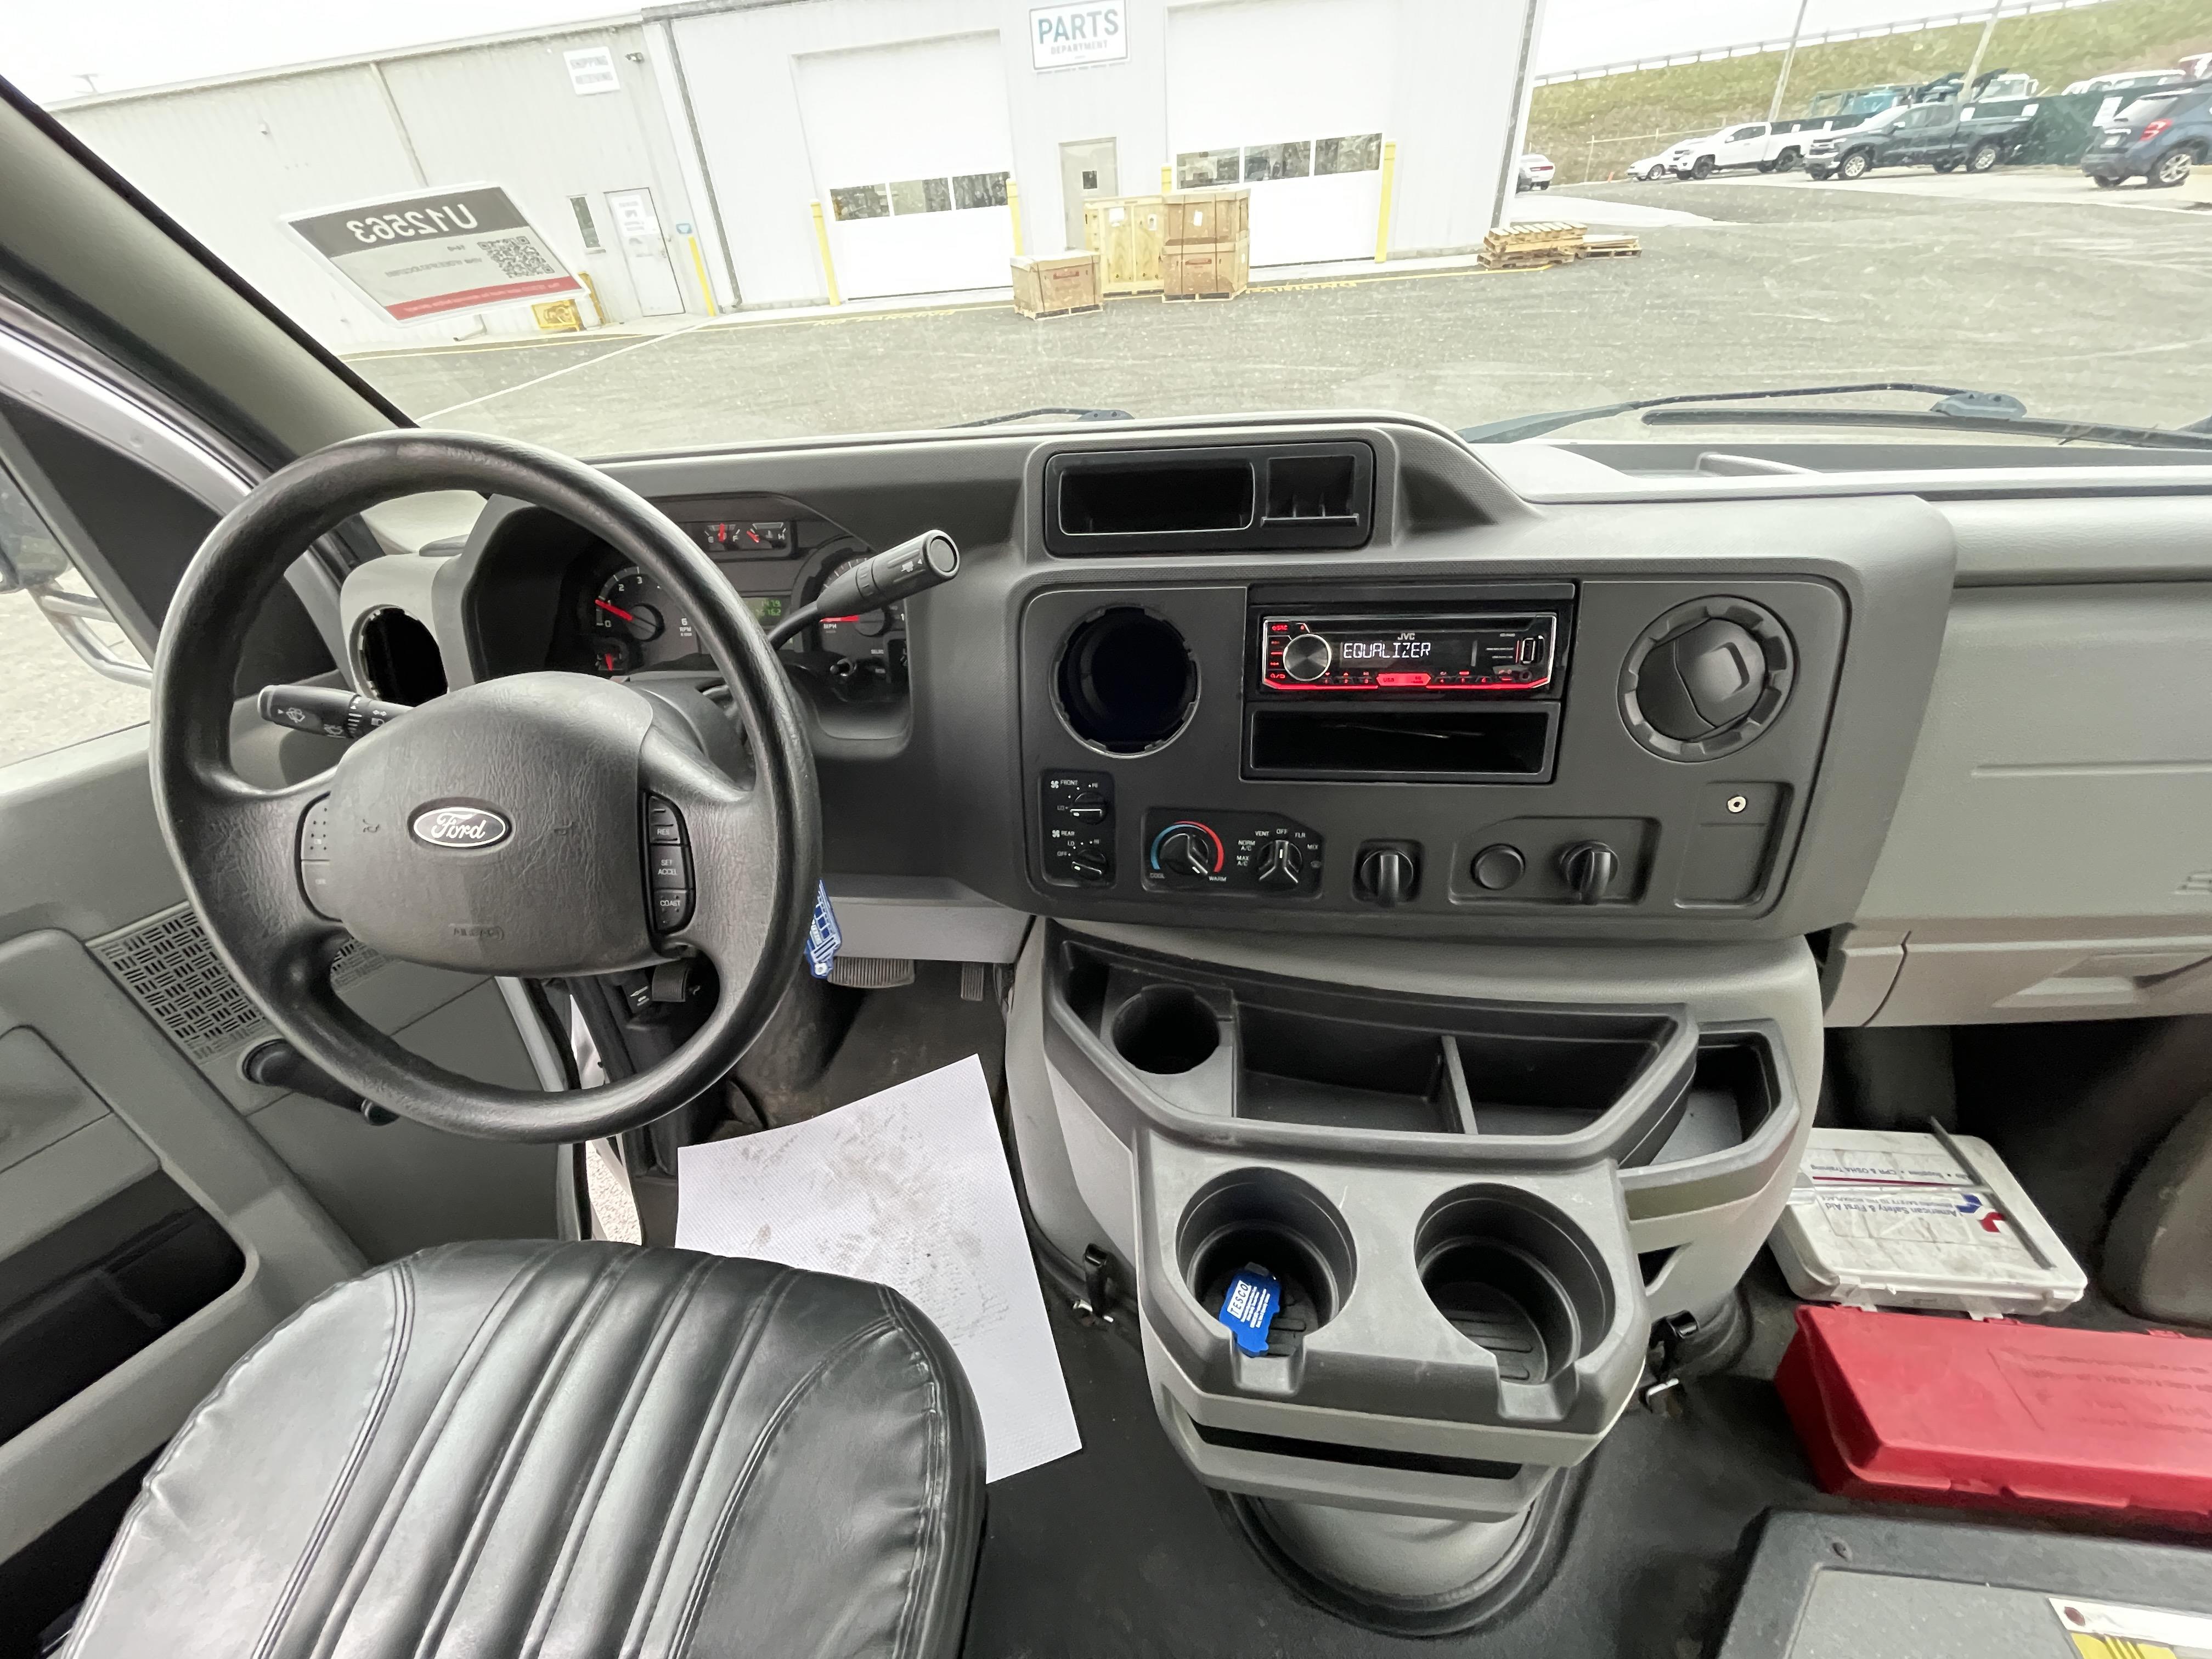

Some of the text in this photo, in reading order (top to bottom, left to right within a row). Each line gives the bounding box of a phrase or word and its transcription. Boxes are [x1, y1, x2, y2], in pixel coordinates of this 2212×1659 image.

[1038, 9, 1119, 44] PARTS
[1051, 40, 1108, 55] DEPARTMENT
[636, 576, 643, 584] 3
[681, 618, 688, 626] 6
[1343, 642, 1431, 659] EQUALIZER
[431, 812, 487, 839] Ford
[1810, 1164, 1844, 1172] Training
[1825, 1203, 1842, 1211] Aid
[1843, 1204, 1868, 1212] First
[1878, 1203, 1910, 1215] Safety
[1910, 1207, 1957, 1217] American
[1230, 1283, 1249, 1316] TESCO
